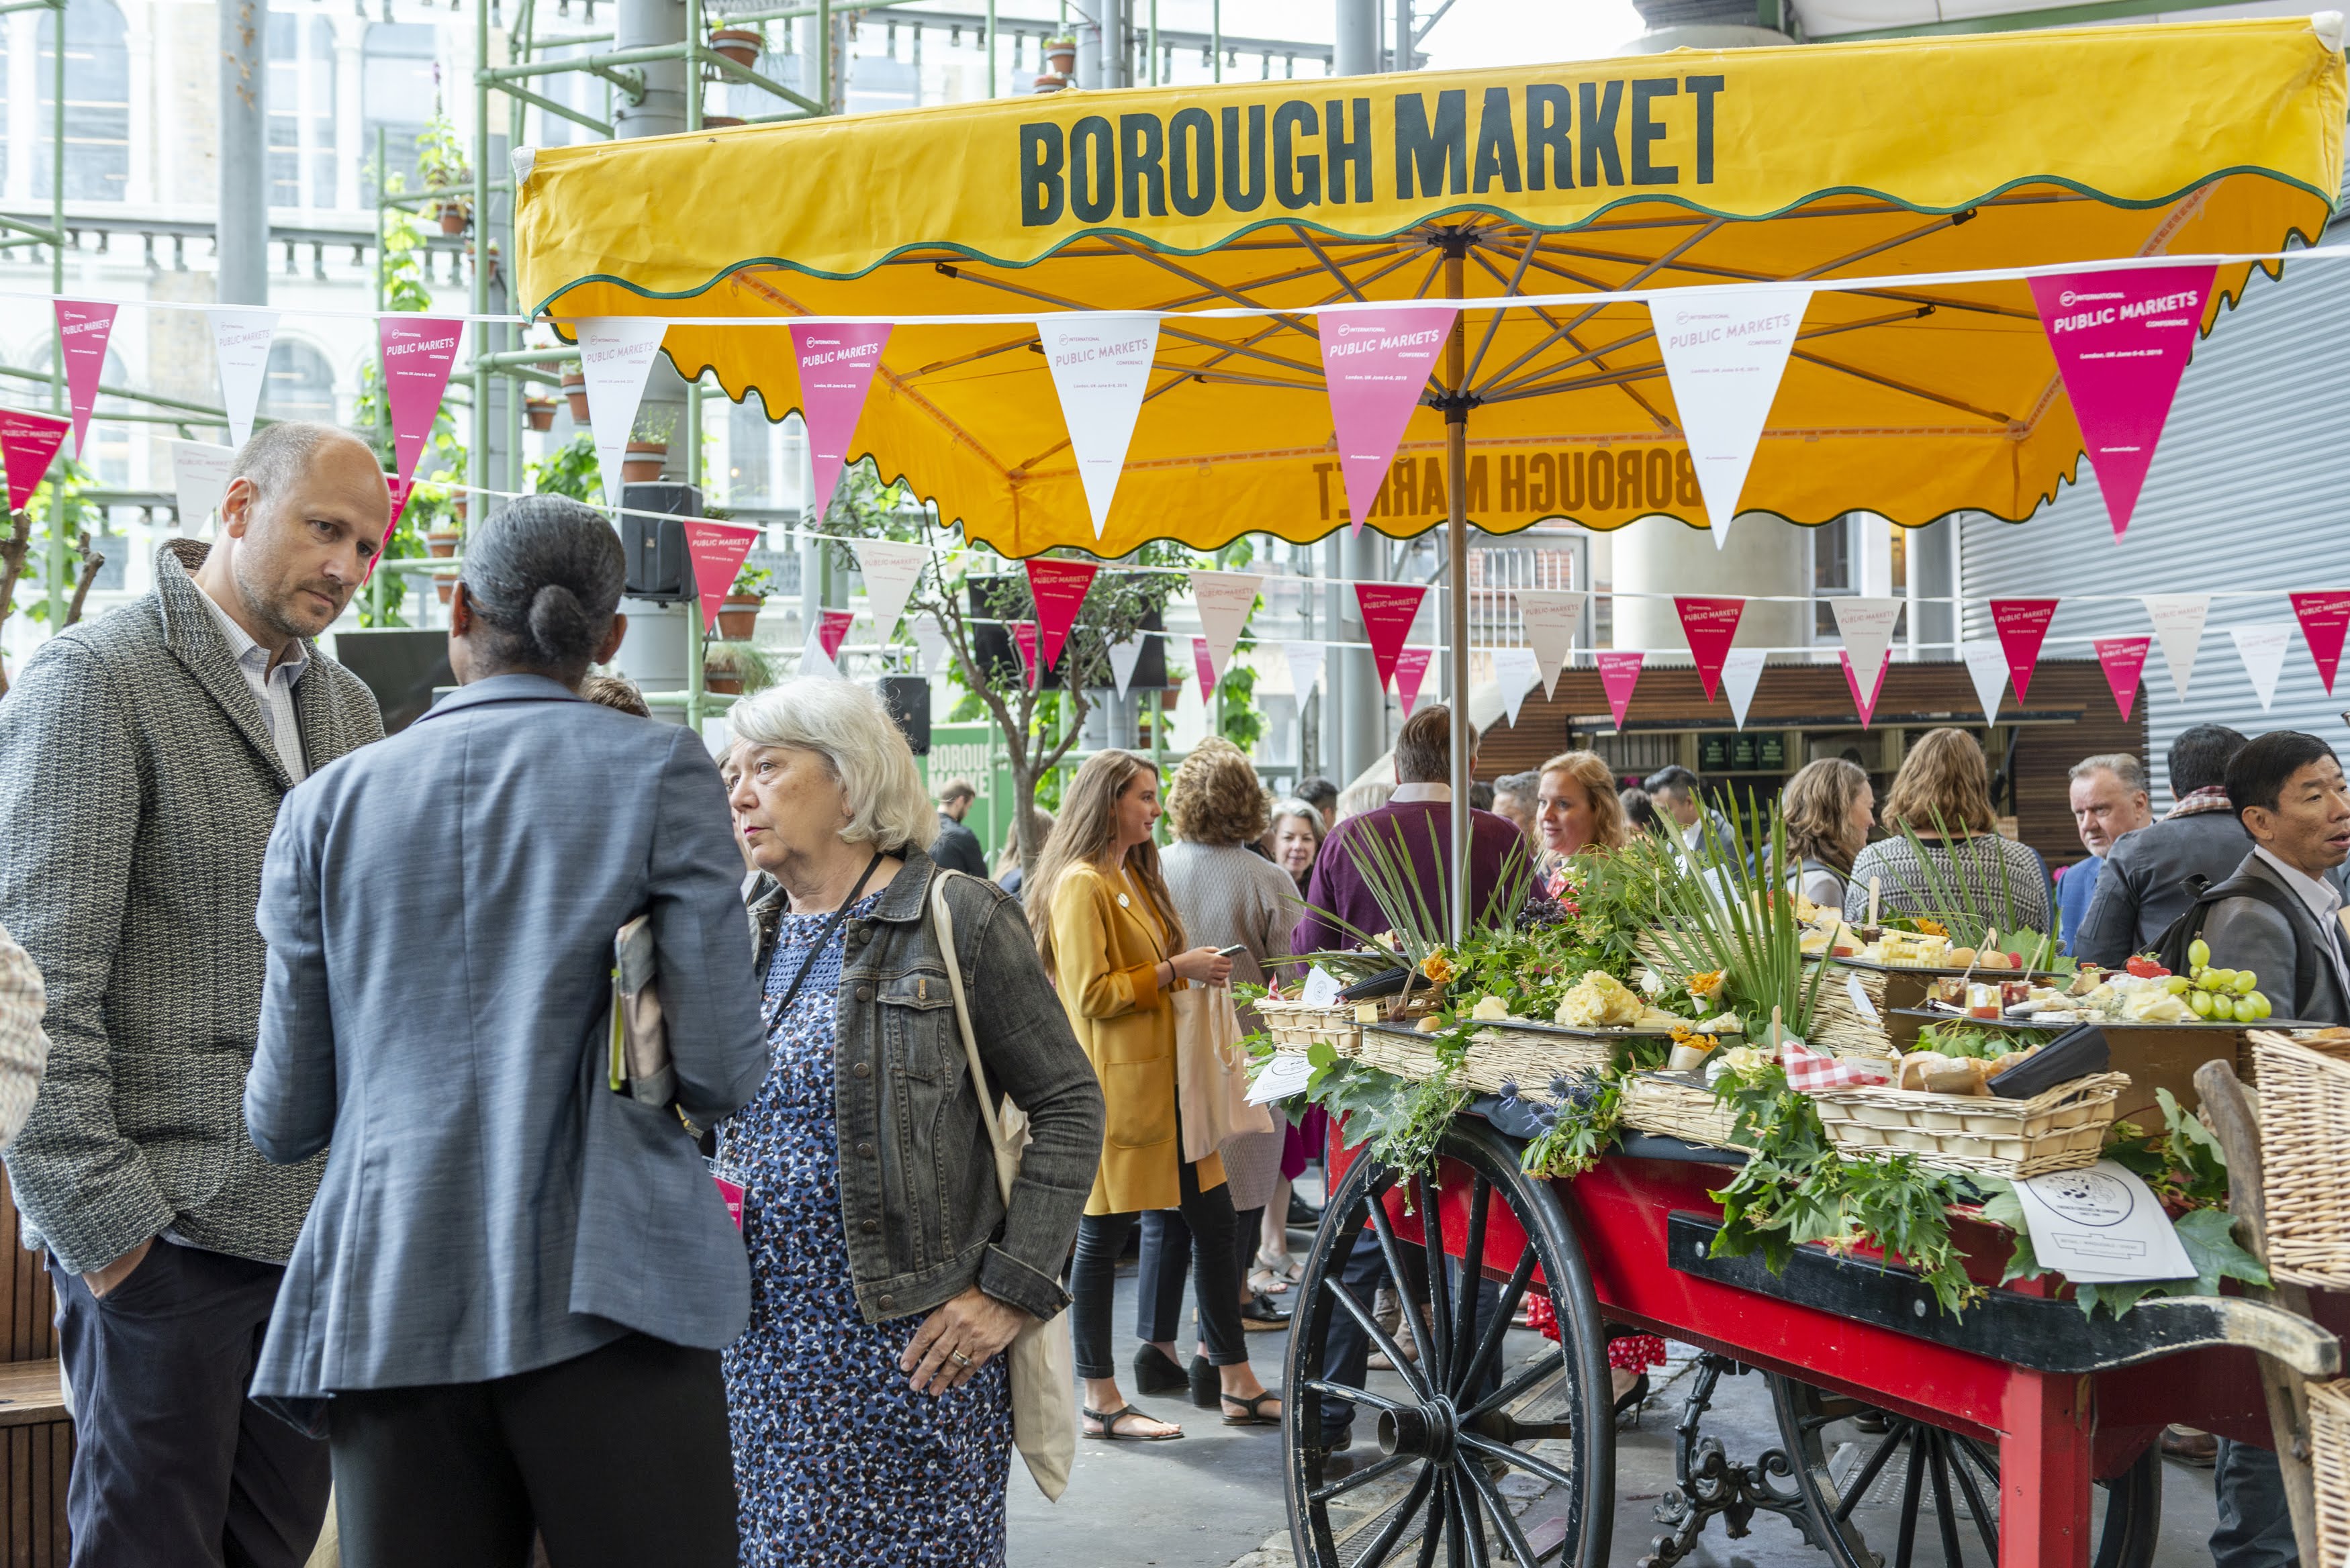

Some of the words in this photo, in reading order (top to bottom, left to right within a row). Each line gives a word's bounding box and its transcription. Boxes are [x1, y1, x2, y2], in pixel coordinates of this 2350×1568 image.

[1020, 98, 1373, 226] BOROUGH
[1395, 75, 1725, 200] MARKET
[2054, 308, 2115, 334] PUBLIC
[2120, 290, 2198, 320] MARKETS
[62, 324, 83, 336] PUBLIC
[84, 319, 109, 331] MARKETS
[220, 335, 241, 347] PUBLIC
[242, 328, 270, 342] MARKETS
[1670, 328, 1721, 349] PUBLIC
[1726, 313, 1791, 338] MARKETS
[387, 343, 416, 356] PUBLIC
[418, 338, 455, 352] MARKETS
[587, 349, 615, 363] PUBLIC
[617, 342, 654, 357] MARKETS
[1055, 349, 1094, 366] PUBLIC
[1099, 338, 1148, 358] MARKETS
[1329, 340, 1376, 357] PUBLIC
[1380, 329, 1440, 350] MARKETS
[802, 351, 835, 367] PUBLIC
[837, 343, 878, 360] MARKETS
[1033, 576, 1058, 584] PUBLIC
[1058, 575, 1089, 583] MARKETS
[1363, 601, 1387, 609] PUBLIC
[1388, 597, 1418, 607] MARKETS
[1684, 612, 1707, 622] PUBLIC
[1709, 608, 1738, 618] MARKETS
[1998, 613, 2021, 623] PUBLIC
[2022, 608, 2051, 619] MARKETS
